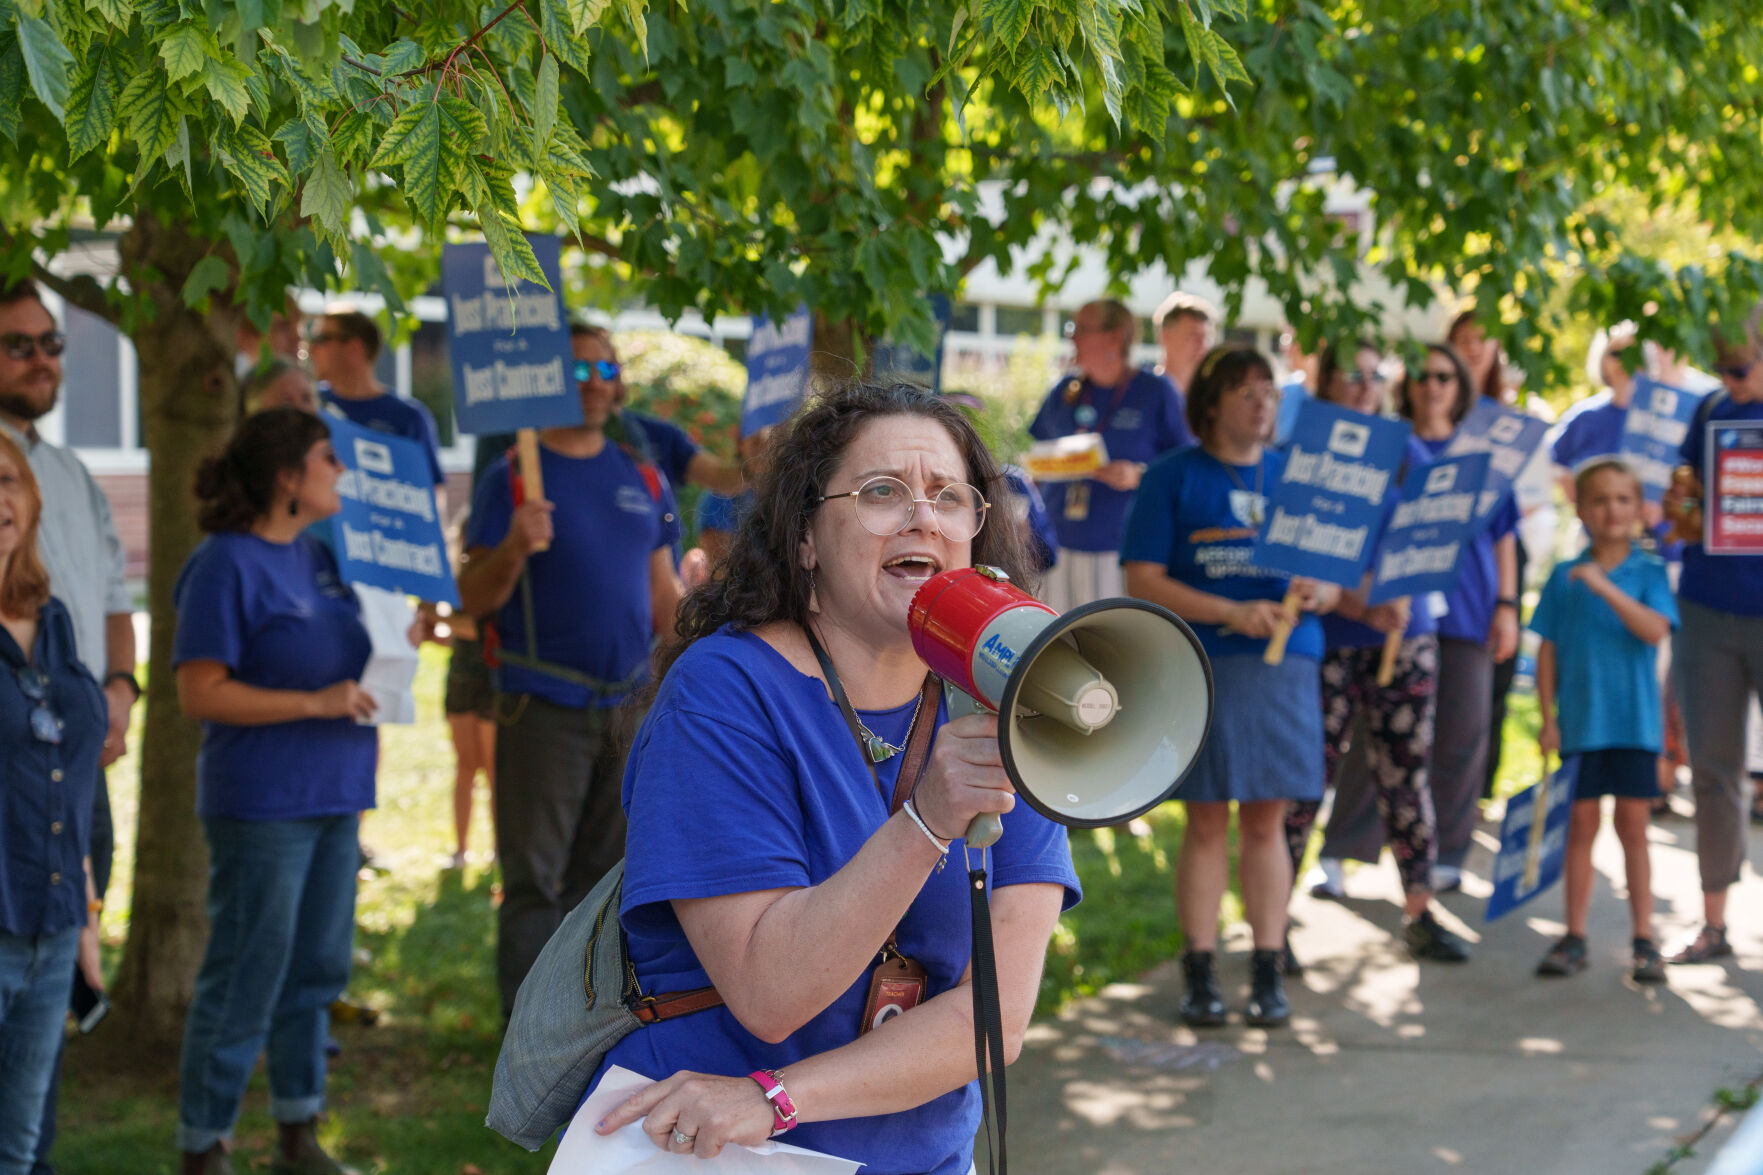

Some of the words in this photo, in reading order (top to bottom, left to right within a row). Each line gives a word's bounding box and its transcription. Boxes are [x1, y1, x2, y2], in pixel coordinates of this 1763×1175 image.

[454, 294, 482, 336] Just
[463, 363, 494, 406] Just
[495, 356, 566, 400] Contract
[357, 468, 435, 522] Practicing
[1283, 445, 1318, 484] Just
[1317, 450, 1391, 505] Practicing
[342, 521, 373, 563] Just
[373, 529, 444, 578] Contract
[1266, 507, 1300, 546] Just
[1298, 513, 1368, 562] Contract
